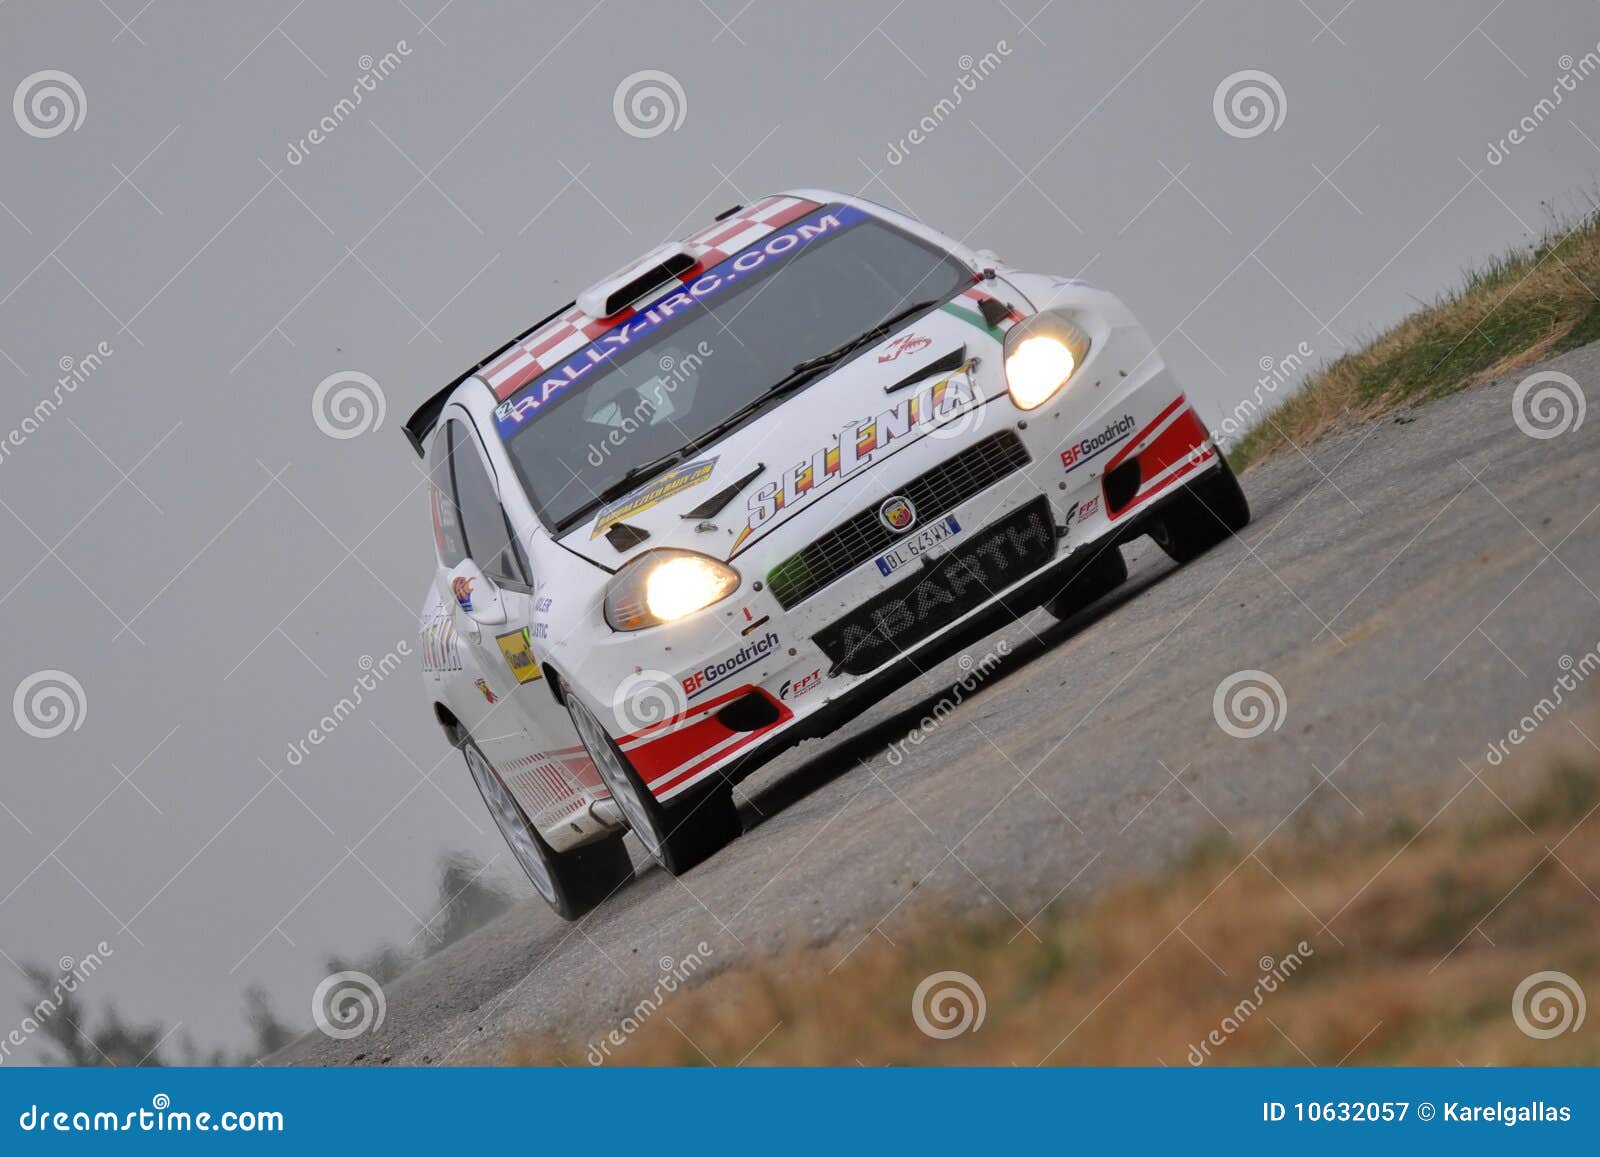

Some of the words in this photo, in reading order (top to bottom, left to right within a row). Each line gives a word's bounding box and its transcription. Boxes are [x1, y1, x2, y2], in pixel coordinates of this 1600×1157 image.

[508, 213, 842, 423] RALLY-IRC.COM
[1060, 414, 1136, 468] BFGoodrich
[841, 510, 1050, 665] ABARTH
[885, 550, 907, 569] DL
[682, 632, 780, 695] BFGoodrich
[792, 668, 821, 693] FPT
